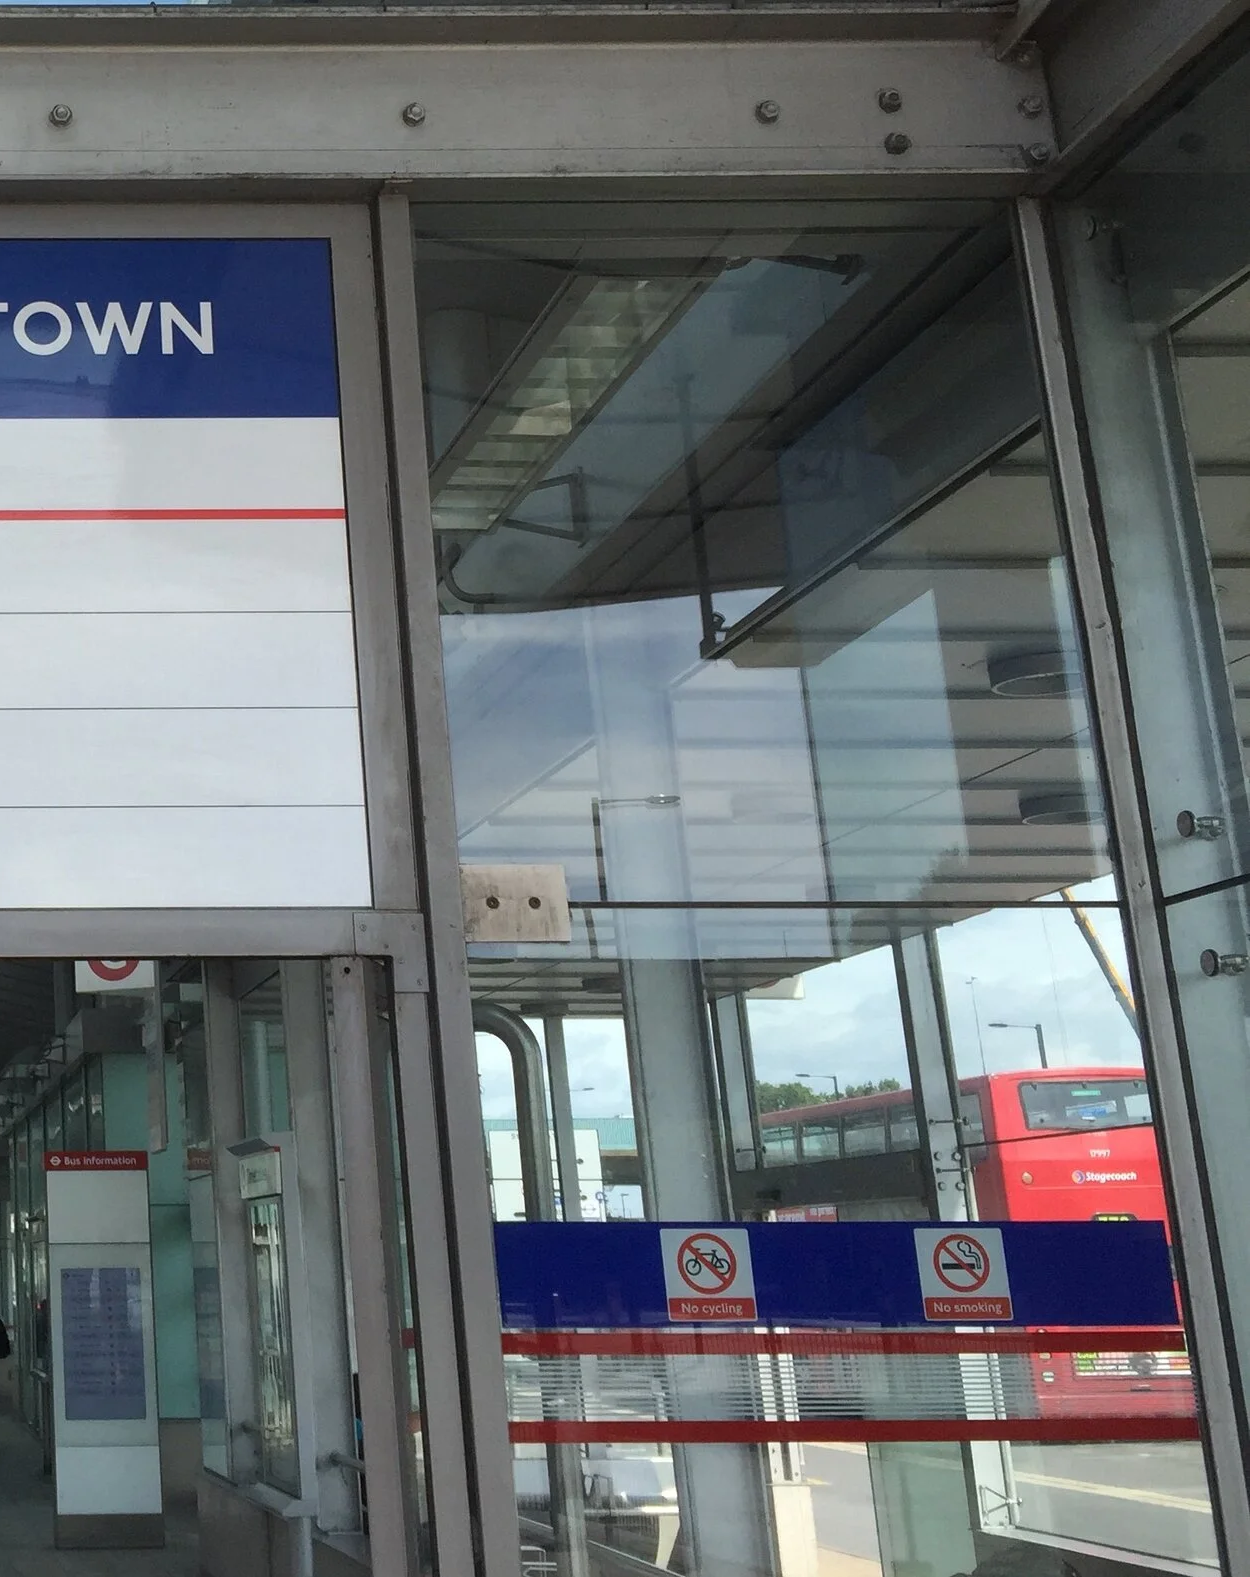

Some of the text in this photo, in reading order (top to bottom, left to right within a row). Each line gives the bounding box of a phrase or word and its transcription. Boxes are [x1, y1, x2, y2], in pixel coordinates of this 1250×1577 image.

[64, 1155, 137, 1166] Bus information
[1085, 1171, 1137, 1184] Stagecoach
[681, 1302, 743, 1316] No cycling
[933, 1301, 1003, 1315] No smoking
